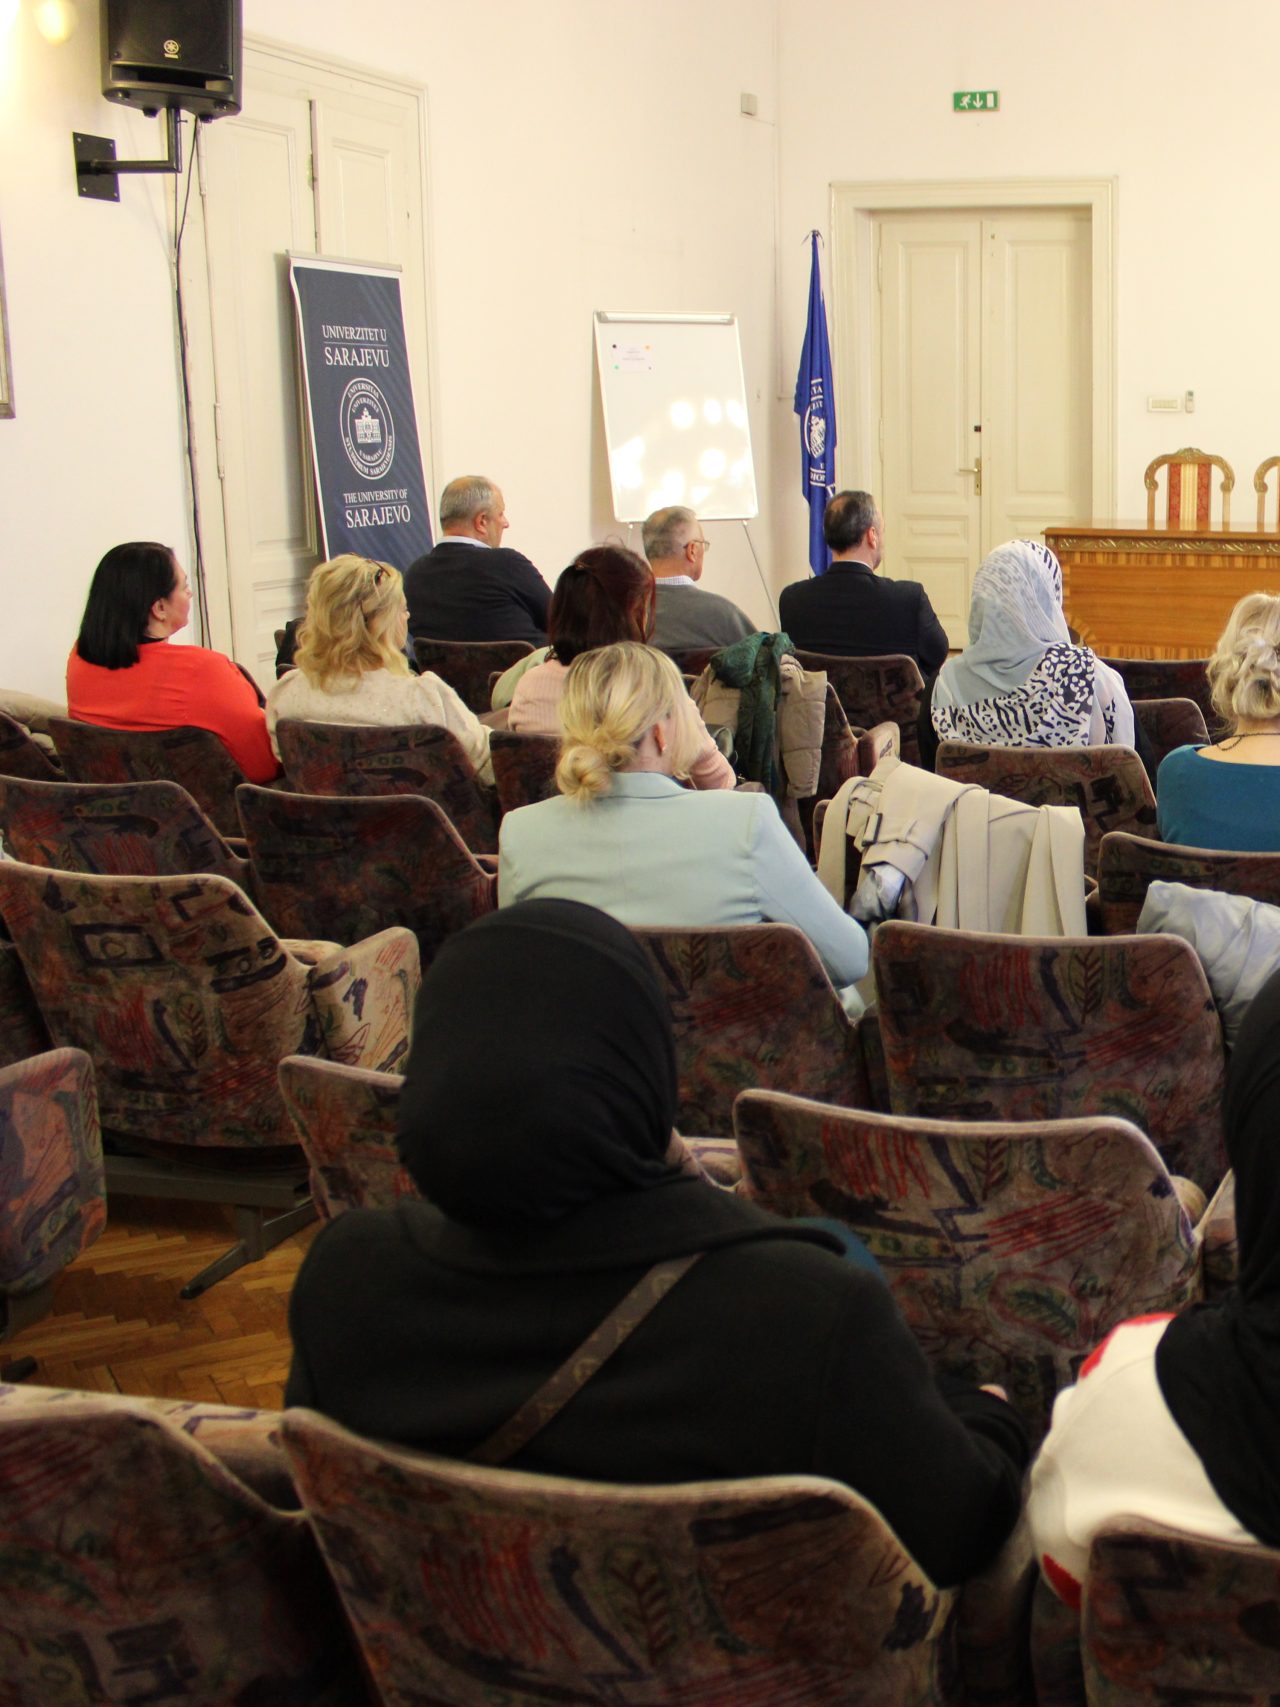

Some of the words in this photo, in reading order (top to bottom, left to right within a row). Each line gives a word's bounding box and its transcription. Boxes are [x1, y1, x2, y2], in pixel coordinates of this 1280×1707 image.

[321, 324, 378, 341] UNIVERZITET
[379, 328, 387, 342] U
[324, 346, 390, 368] SARAJEVU
[343, 492, 357, 504] THE
[357, 489, 398, 503] UNIVERSITY
[399, 488, 408, 499] OF
[345, 504, 411, 529] SARAJEVO
